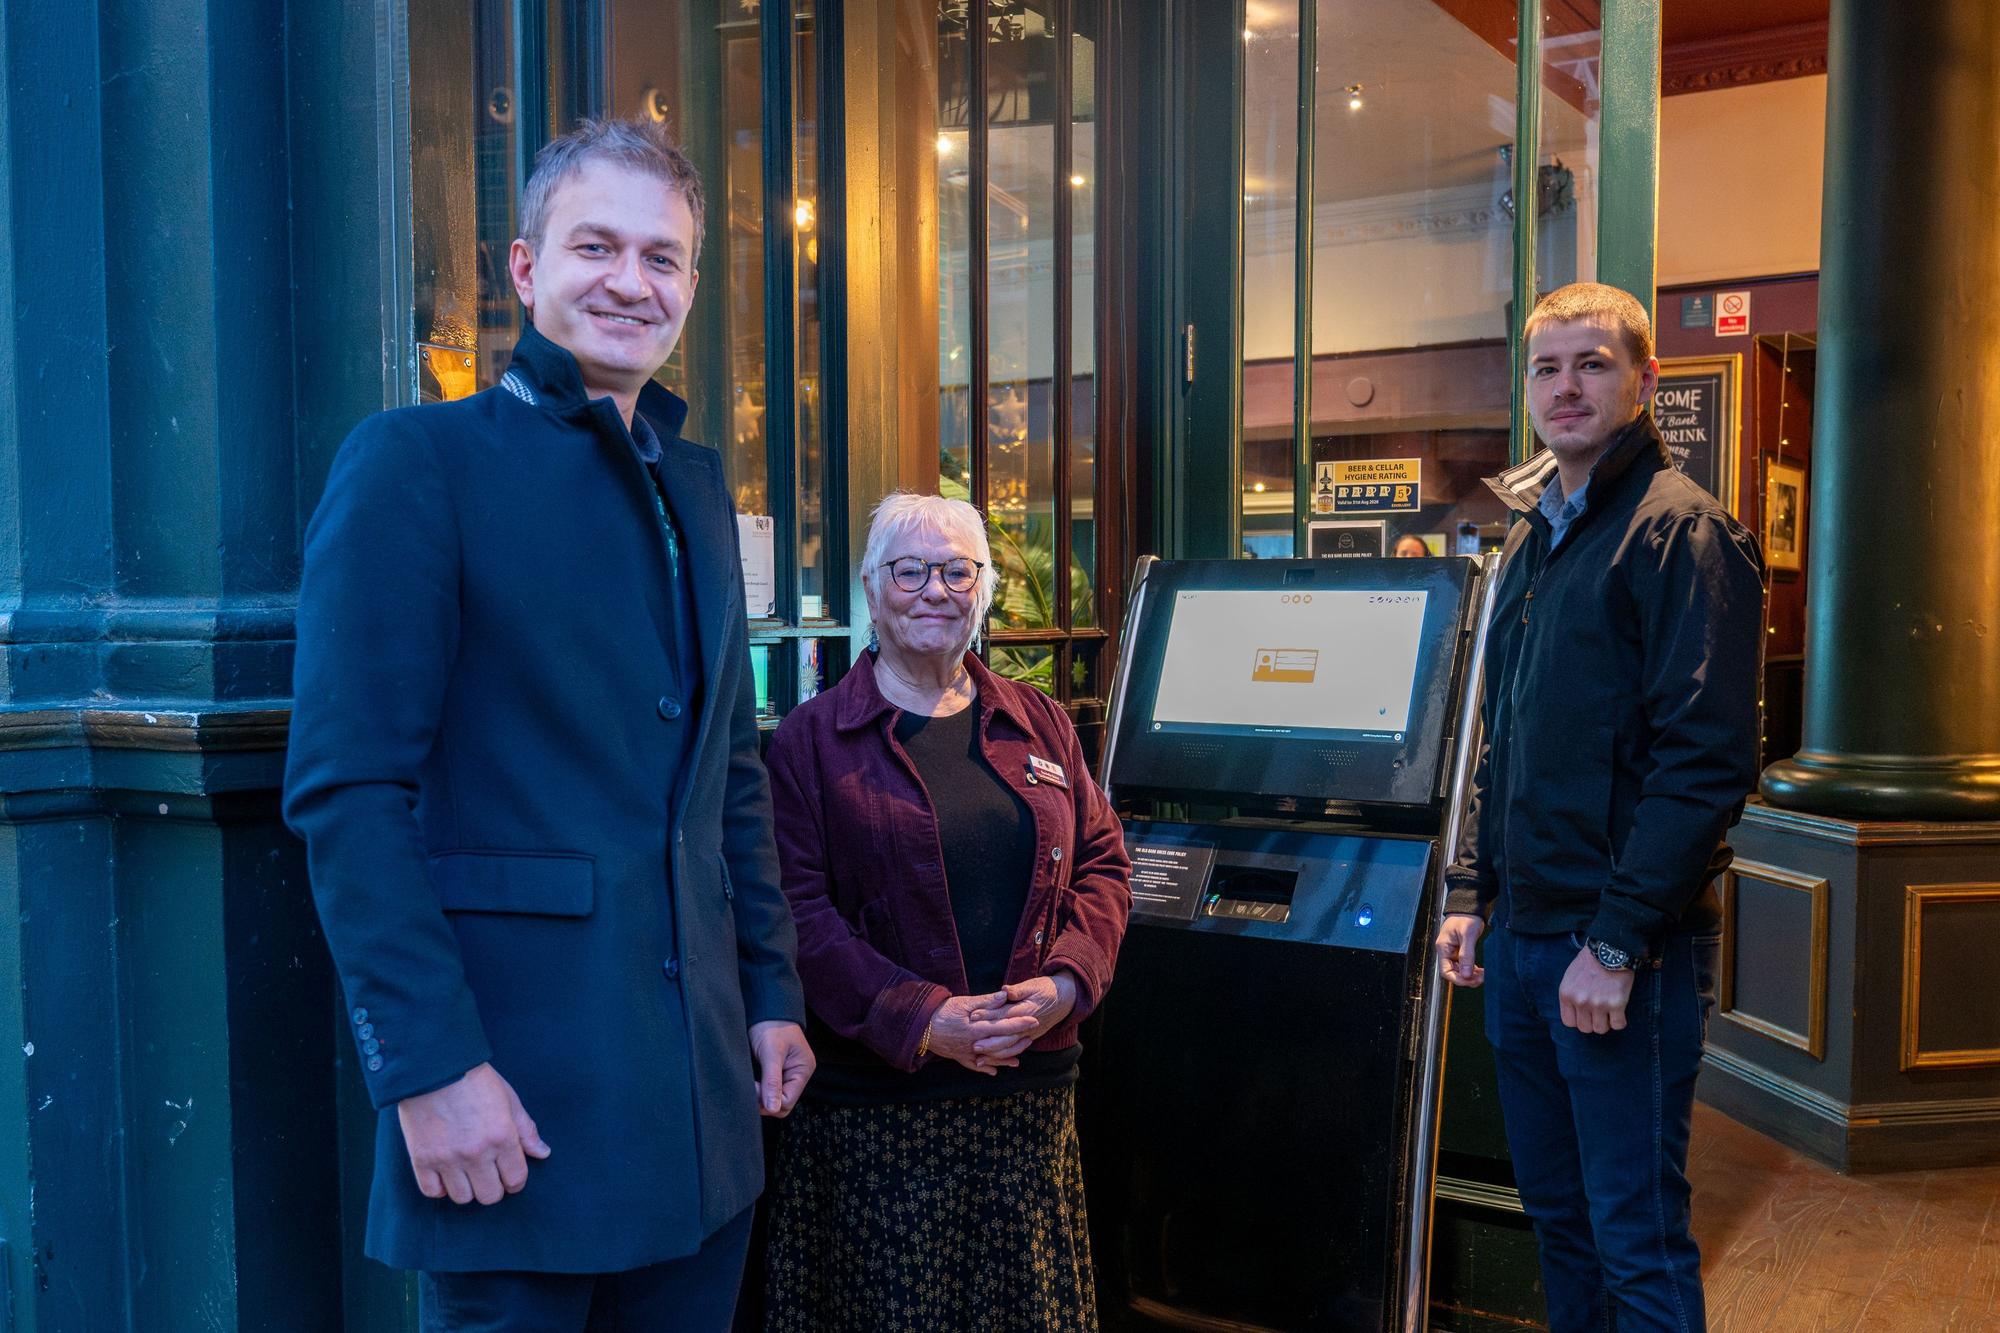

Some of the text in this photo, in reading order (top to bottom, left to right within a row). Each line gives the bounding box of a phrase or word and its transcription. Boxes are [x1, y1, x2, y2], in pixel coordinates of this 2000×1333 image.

[1655, 389, 1702, 410] COME
[1667, 414, 1699, 427] Bank
[1347, 463, 1404, 472] BEER & CELLAR
[1344, 472, 1407, 481] HYGIENE RATING
[1397, 489, 1404, 499] 5
